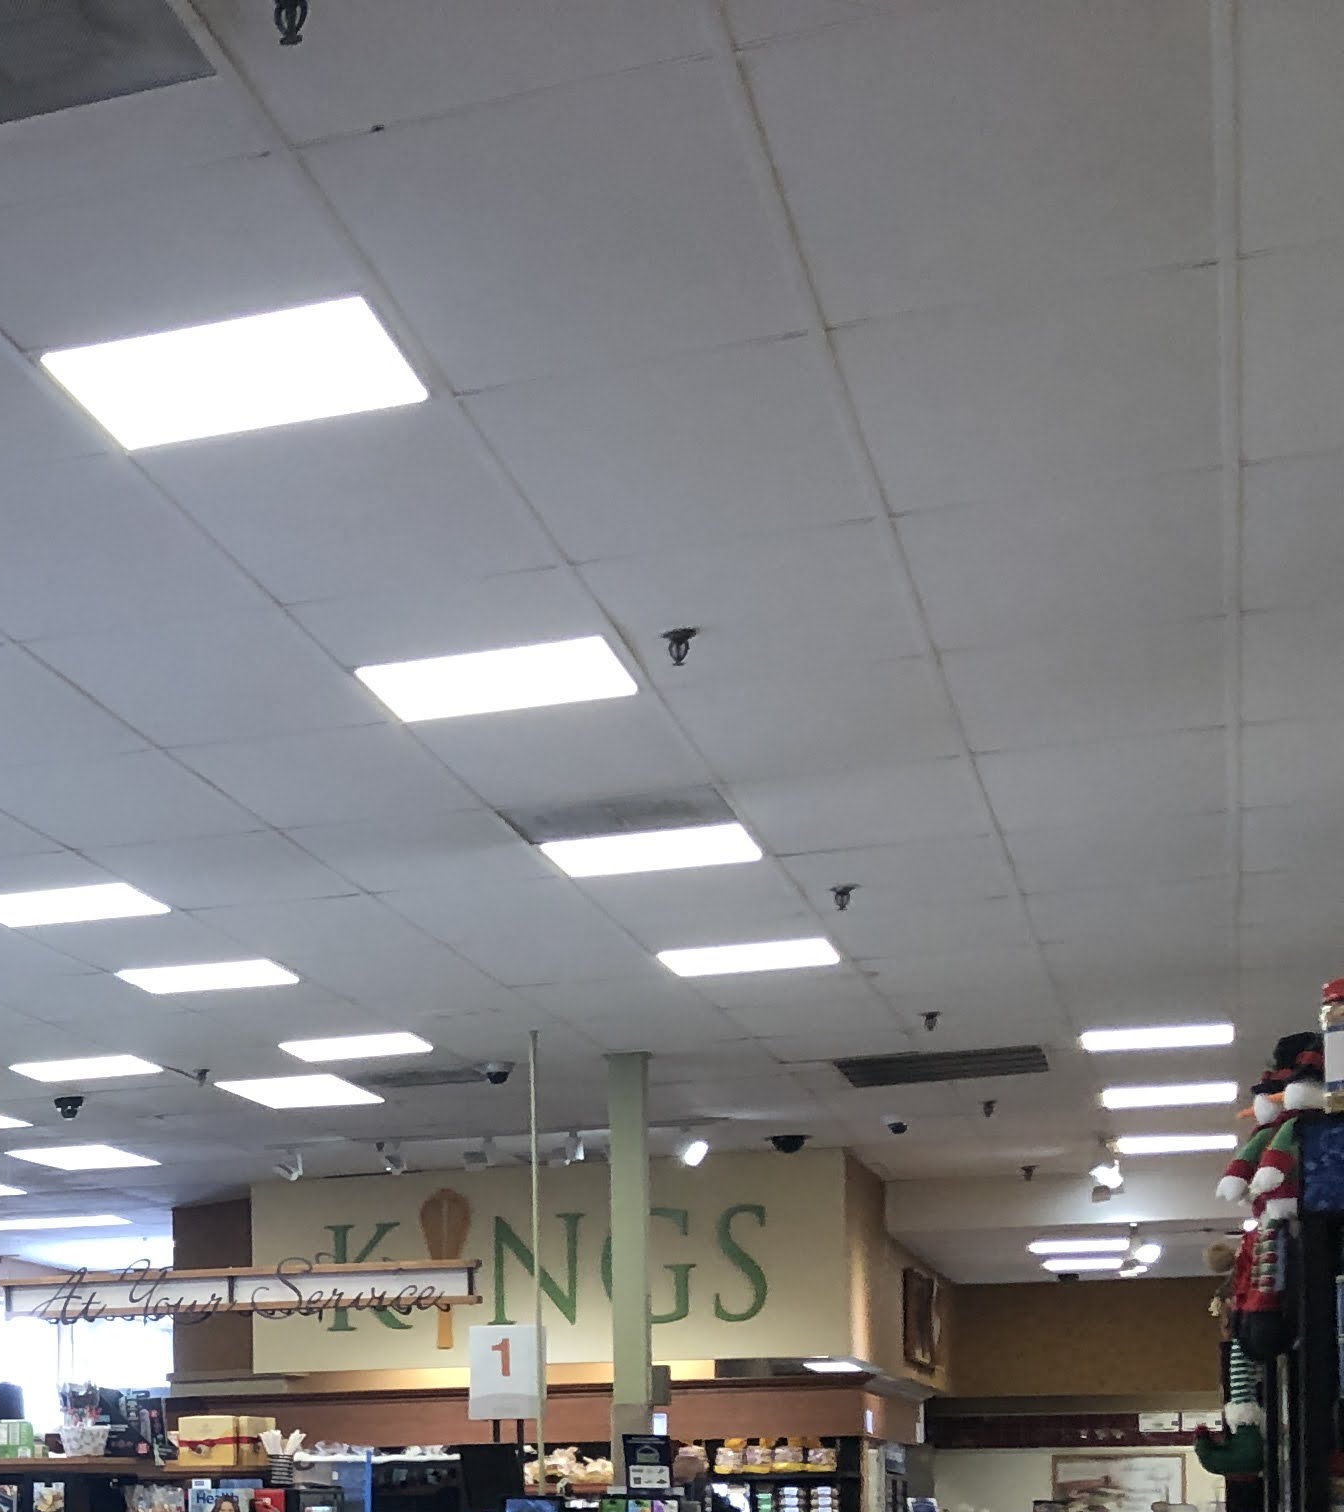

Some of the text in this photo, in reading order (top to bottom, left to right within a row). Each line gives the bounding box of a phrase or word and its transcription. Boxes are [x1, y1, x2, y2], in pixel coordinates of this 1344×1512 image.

[29, 1255, 452, 1327] At Your Service
[491, 1337, 511, 1377] 1
